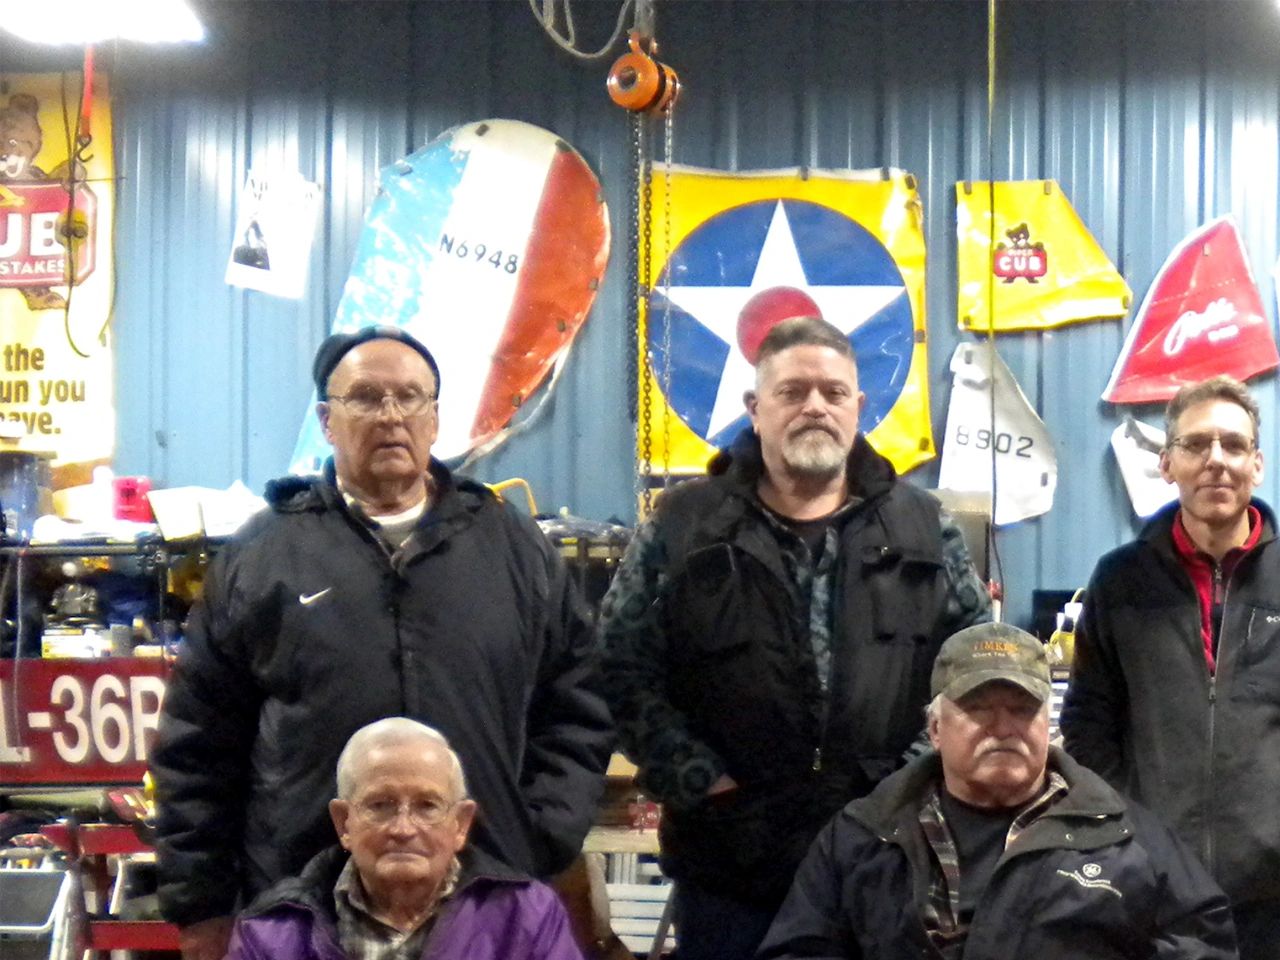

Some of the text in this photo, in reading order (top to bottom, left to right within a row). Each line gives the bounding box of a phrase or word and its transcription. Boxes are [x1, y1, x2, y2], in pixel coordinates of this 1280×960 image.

[439, 233, 518, 274] N6948
[999, 255, 1041, 271] CUB
[4, 342, 45, 372] the
[38, 379, 86, 406] you
